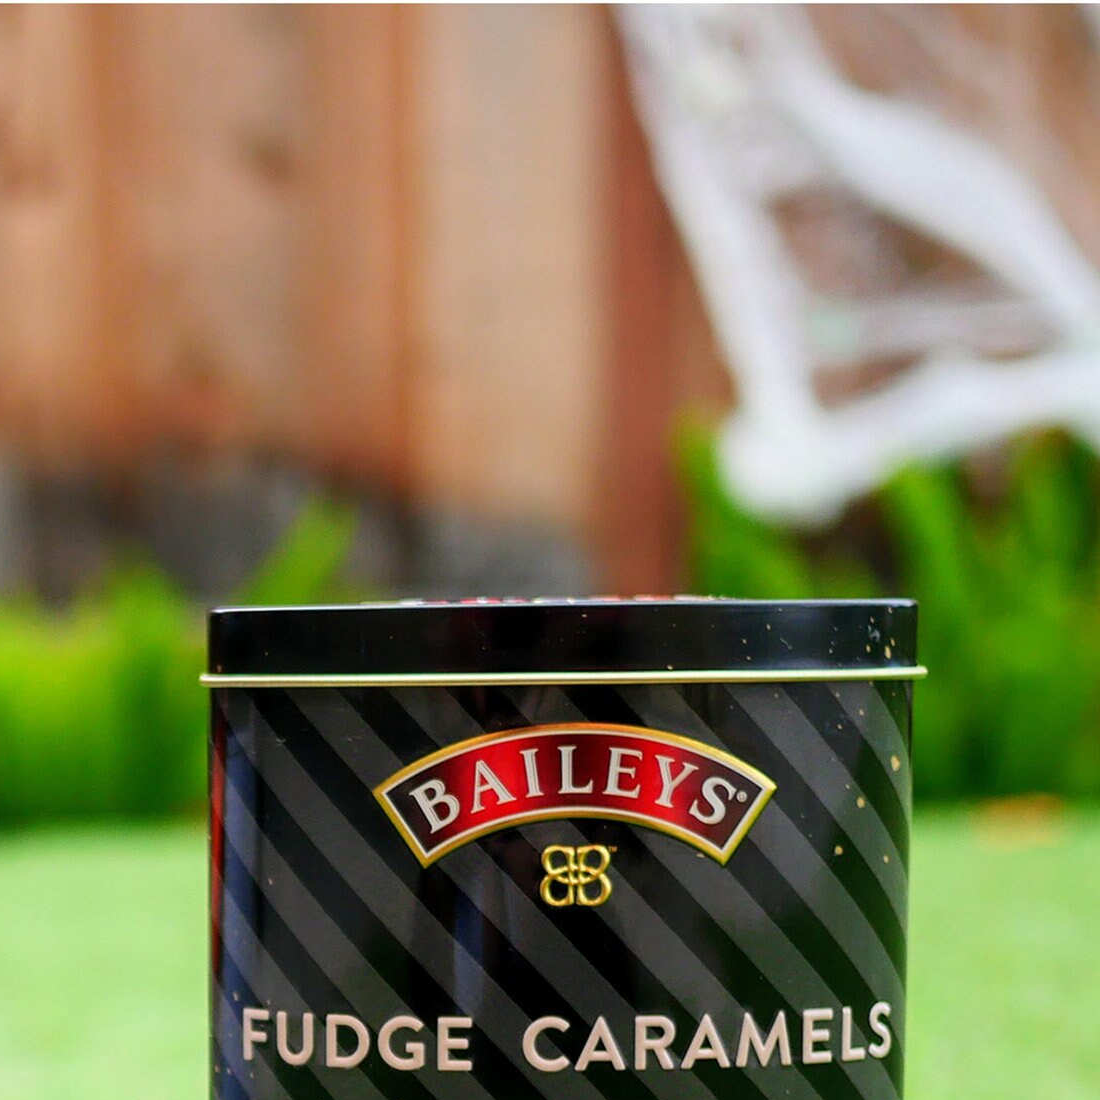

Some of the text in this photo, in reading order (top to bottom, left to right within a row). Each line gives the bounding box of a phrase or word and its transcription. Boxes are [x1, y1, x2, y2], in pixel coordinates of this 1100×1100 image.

[408, 745, 739, 833] BAILEYS
[241, 1001, 893, 1071] FUDGE CARAMELS
